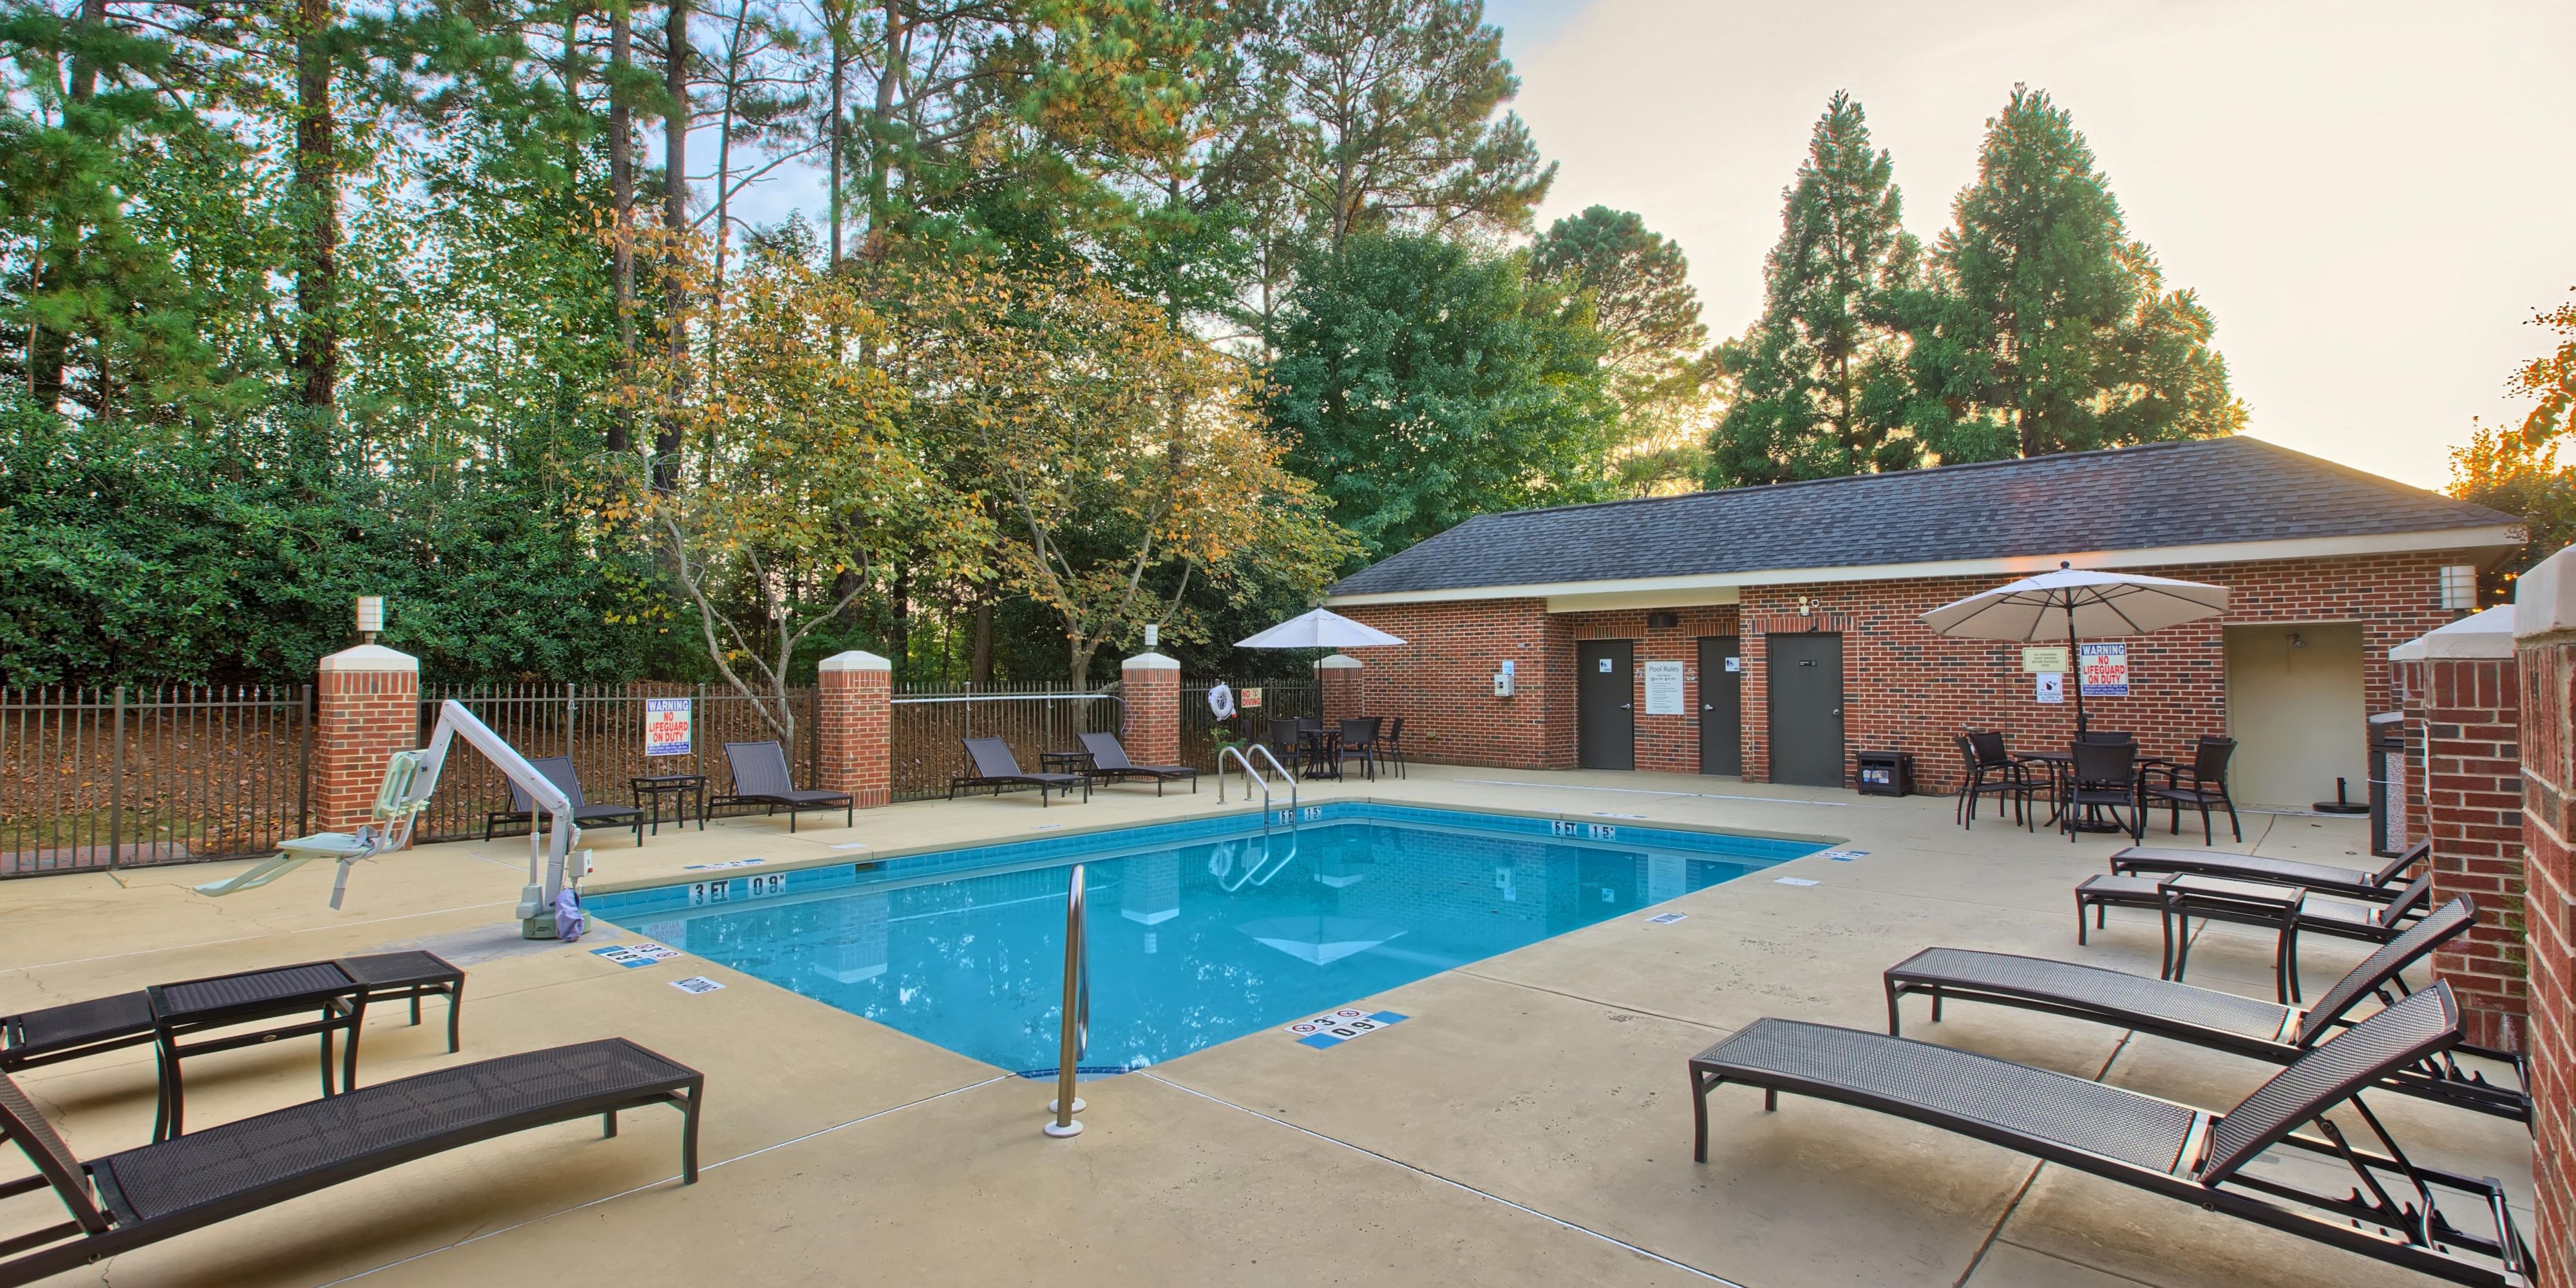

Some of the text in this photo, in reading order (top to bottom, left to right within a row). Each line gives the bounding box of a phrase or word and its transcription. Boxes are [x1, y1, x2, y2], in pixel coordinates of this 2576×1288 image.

[2082, 645, 2125, 655] WARNING
[2098, 656, 2109, 665] NO
[2083, 665, 2125, 674] LIFEGUARD
[2088, 675, 2120, 684] ON DUTY
[649, 700, 689, 711] WARNING
[1242, 698, 1261, 706] DIVING
[664, 712, 674, 721] NO
[649, 722, 688, 732] LIFEGUARD
[653, 732, 683, 742] ON DUTY
[696, 881, 728, 896] 3 FT
